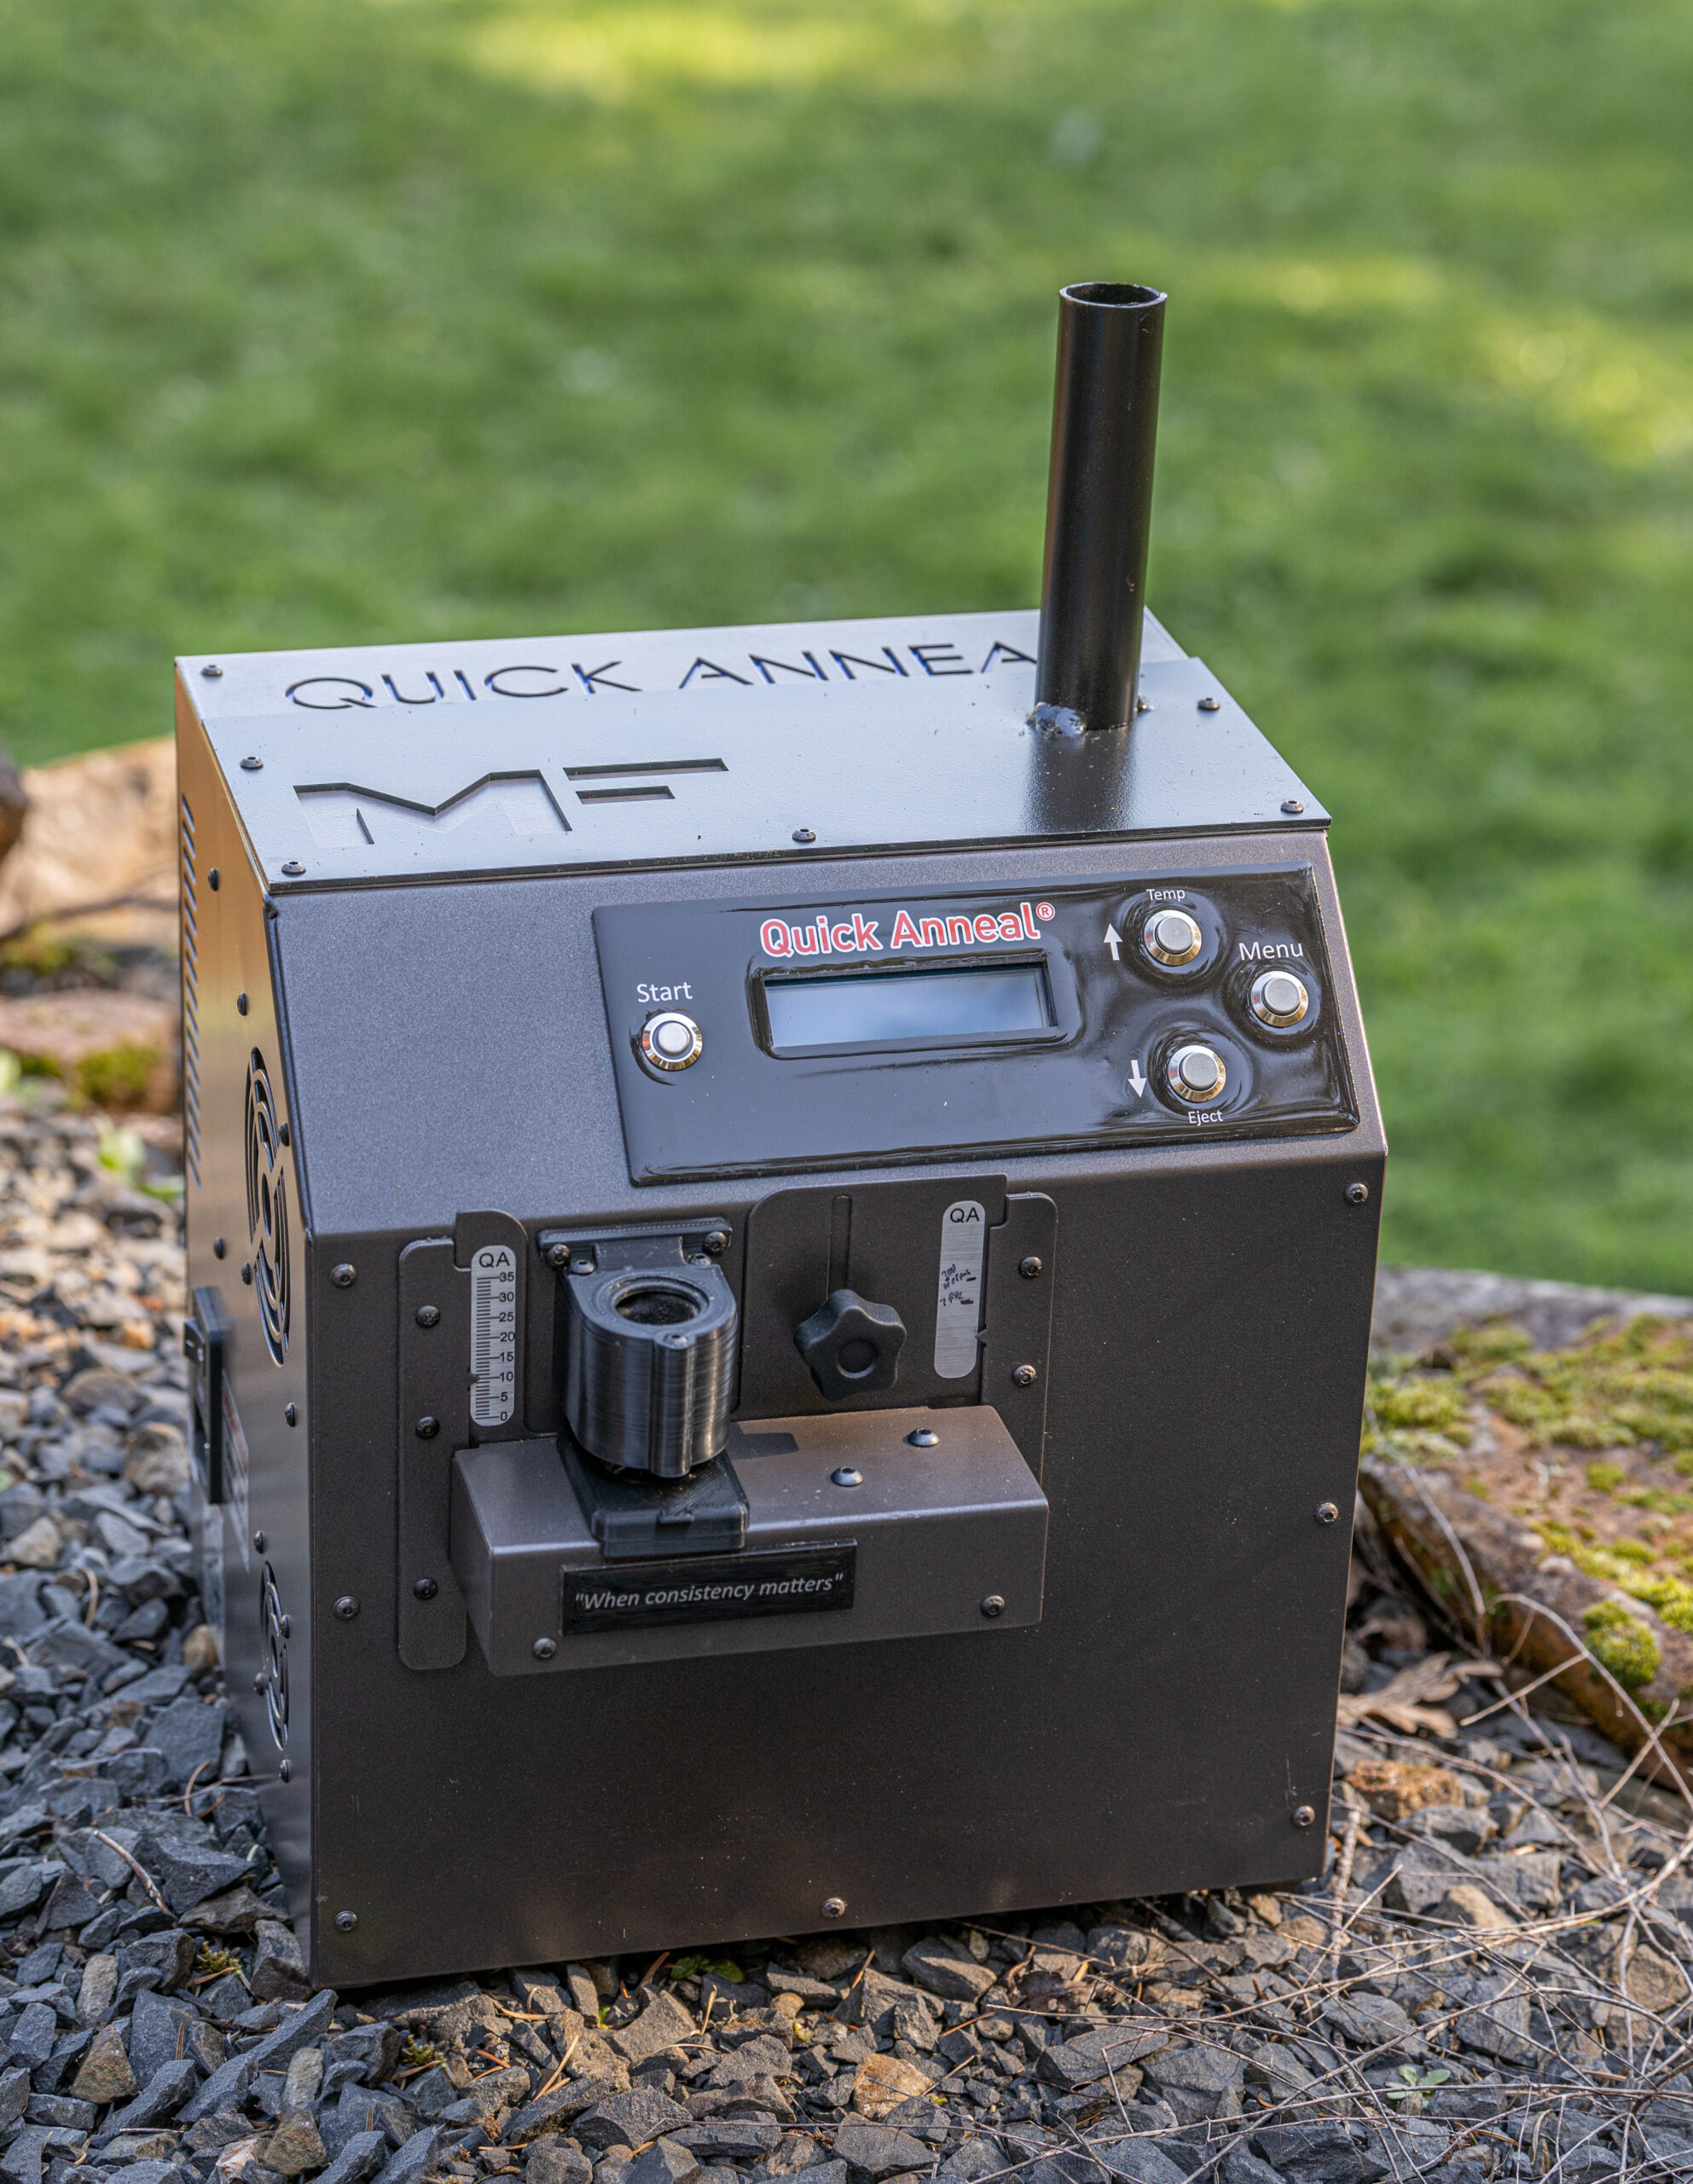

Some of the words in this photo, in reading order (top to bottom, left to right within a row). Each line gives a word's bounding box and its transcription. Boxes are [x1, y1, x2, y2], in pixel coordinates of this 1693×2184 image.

[284, 659, 642, 710] QUICK
[679, 641, 1038, 689] ANNEA
[1146, 888, 1186, 902] Temp
[760, 912, 884, 959] Quick
[1238, 941, 1304, 961] Menu
[636, 981, 693, 1003] Start
[1188, 1110, 1224, 1126] Eject
[949, 1207, 980, 1223] QA
[478, 1252, 511, 1269] QA
[499, 1271, 516, 1282] 35
[499, 1292, 515, 1303] 30
[499, 1311, 515, 1322] 25
[500, 1332, 516, 1342] 20
[500, 1351, 514, 1362] 15
[500, 1371, 514, 1382] 10
[500, 1391, 508, 1403] 5
[500, 1411, 508, 1422] 0
[575, 1591, 640, 1611] "When
[645, 1580, 755, 1605] consistency
[758, 1573, 844, 1595] matters"
